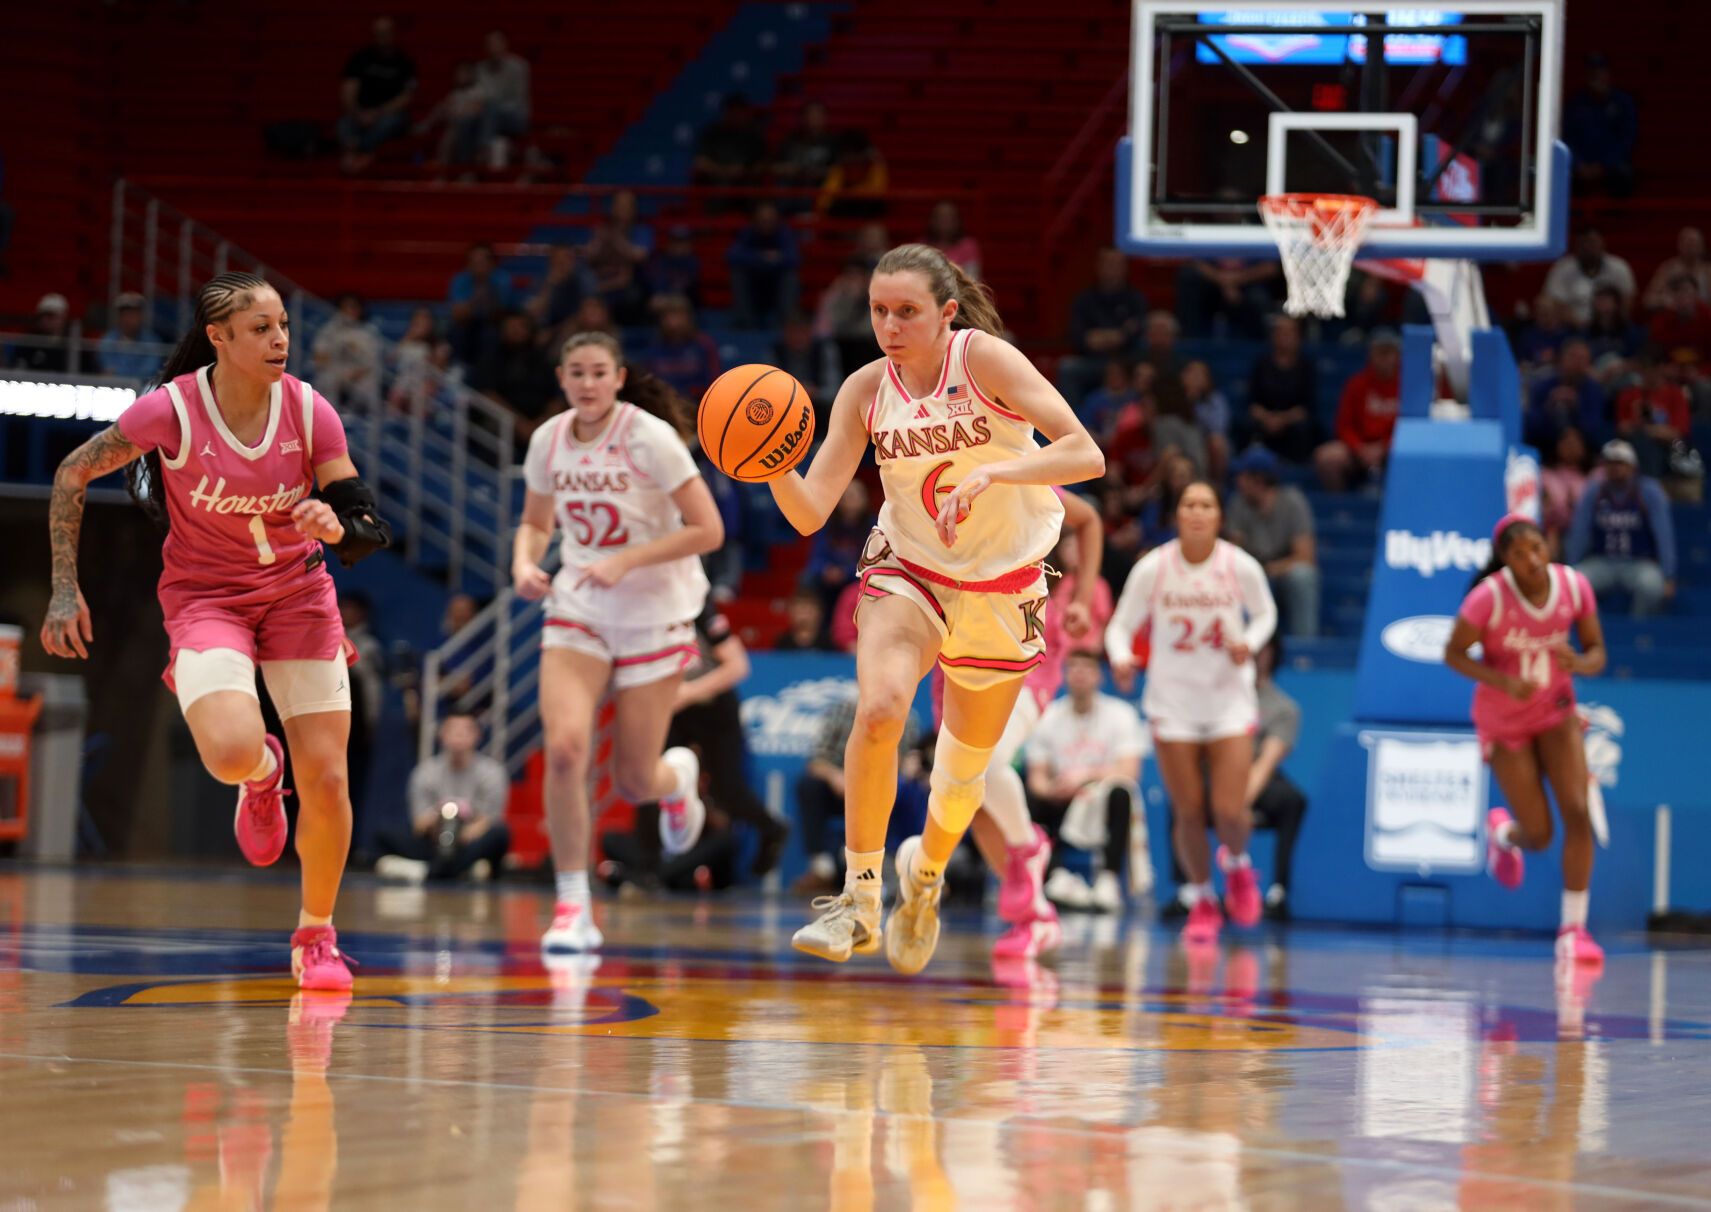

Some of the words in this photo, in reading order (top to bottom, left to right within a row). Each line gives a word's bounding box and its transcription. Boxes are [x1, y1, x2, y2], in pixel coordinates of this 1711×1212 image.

[758, 405, 810, 469] Wilson
[874, 416, 991, 460] KANSAS
[189, 474, 305, 514] Houston
[554, 471, 630, 493] KANSAS
[921, 460, 971, 525] 6
[248, 515, 276, 565] 1
[565, 501, 630, 548] 52
[1019, 595, 1048, 643] K
[1169, 615, 1225, 652] 24
[1519, 650, 1550, 688] 14
